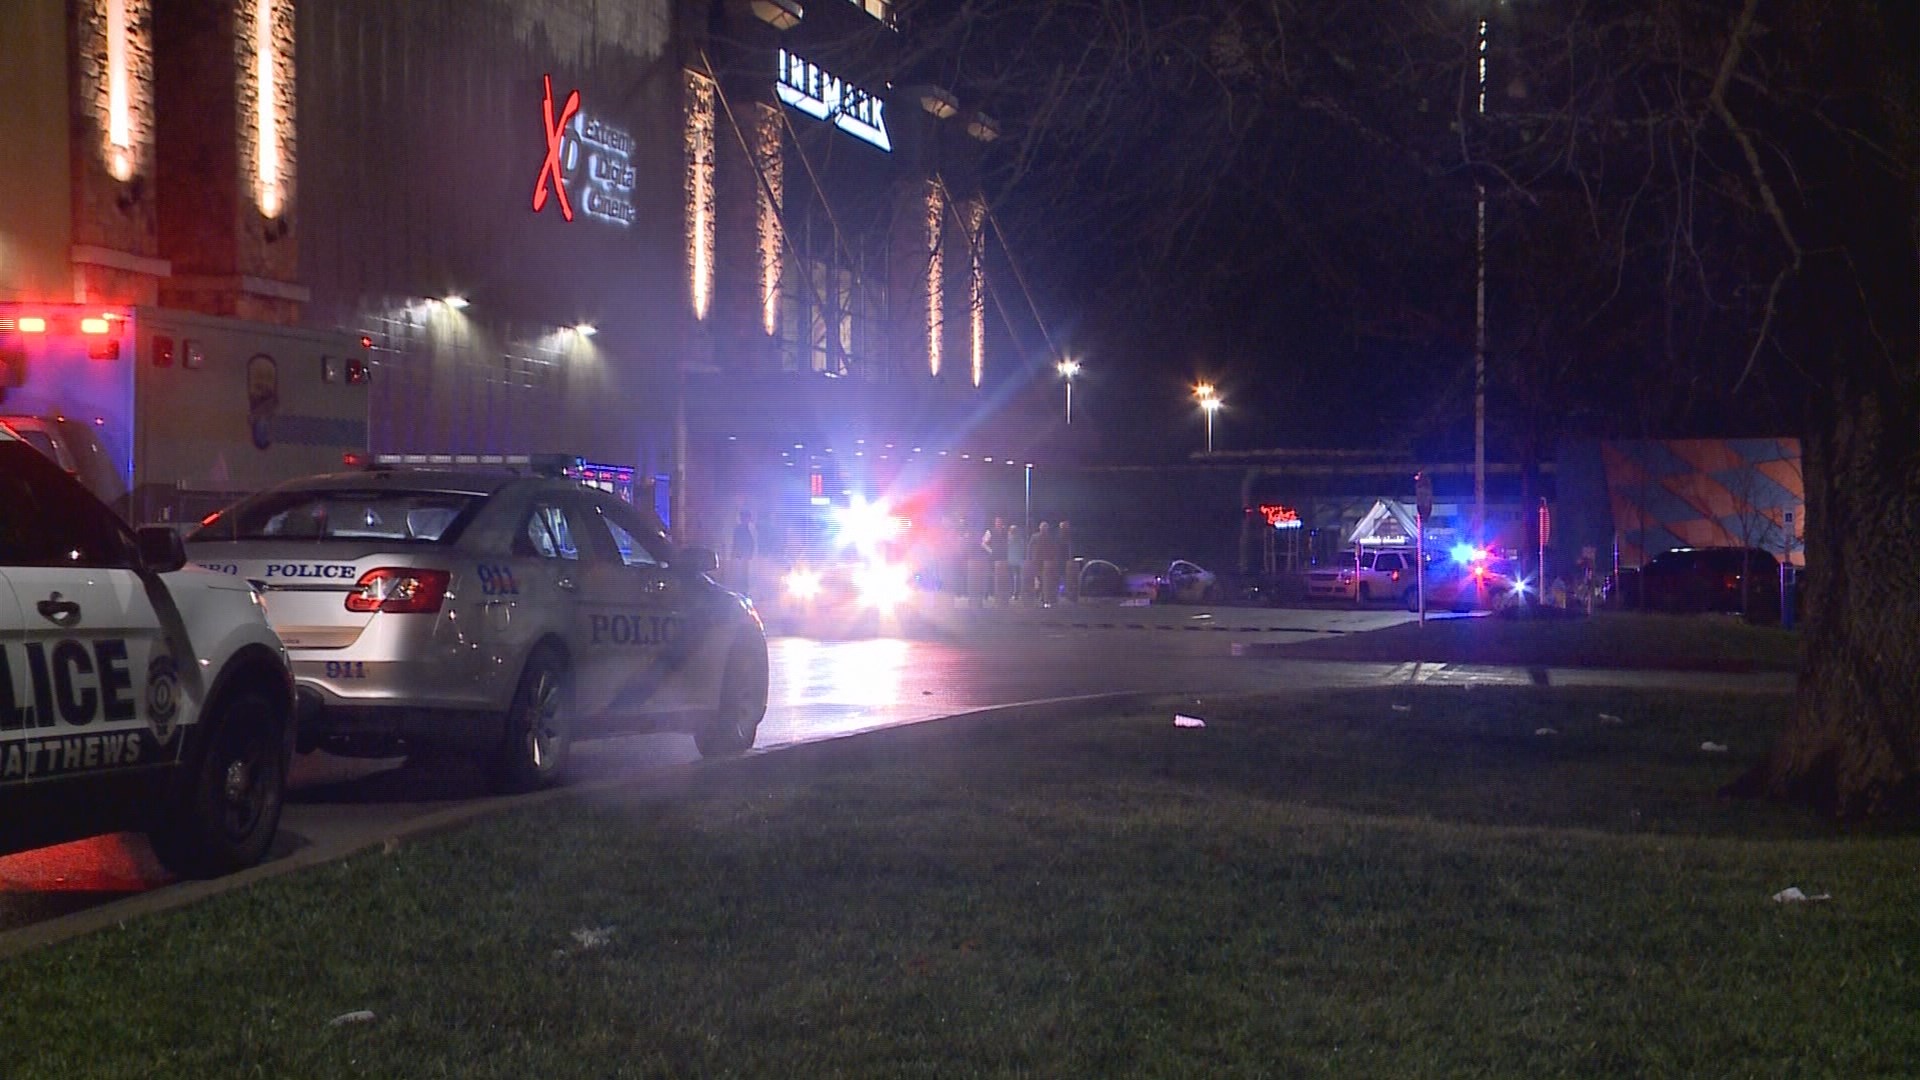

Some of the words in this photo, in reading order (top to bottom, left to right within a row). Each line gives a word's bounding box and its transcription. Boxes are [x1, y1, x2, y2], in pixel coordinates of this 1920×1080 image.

[582, 186, 637, 225] Cinema
[266, 564, 356, 579] POLICE
[477, 564, 519, 595] 911
[588, 613, 689, 646] POLIC
[326, 661, 366, 679] 911
[0, 732, 142, 778] ATTHEWS
